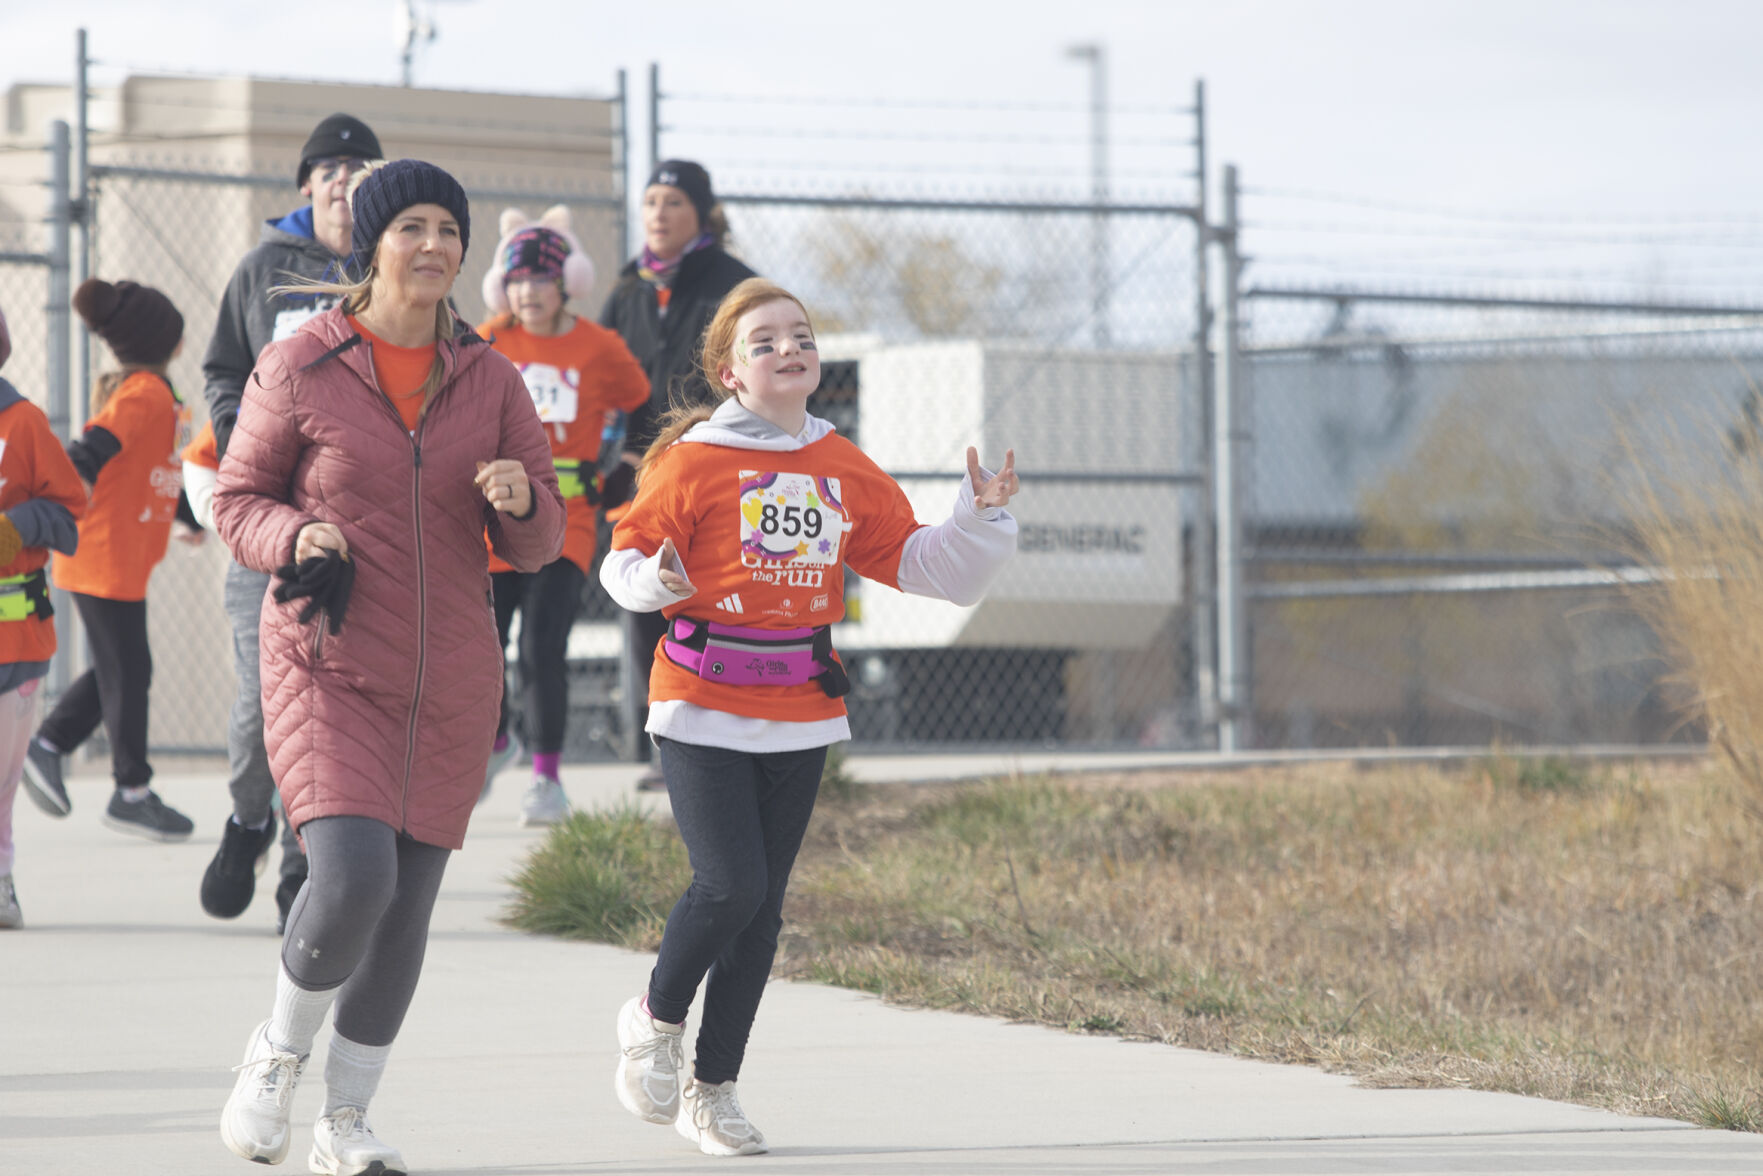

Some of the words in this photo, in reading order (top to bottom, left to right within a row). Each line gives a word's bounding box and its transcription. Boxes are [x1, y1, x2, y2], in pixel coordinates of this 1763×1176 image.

[760, 503, 823, 539] 859
[752, 570, 773, 583] the
[771, 569, 823, 588] run
